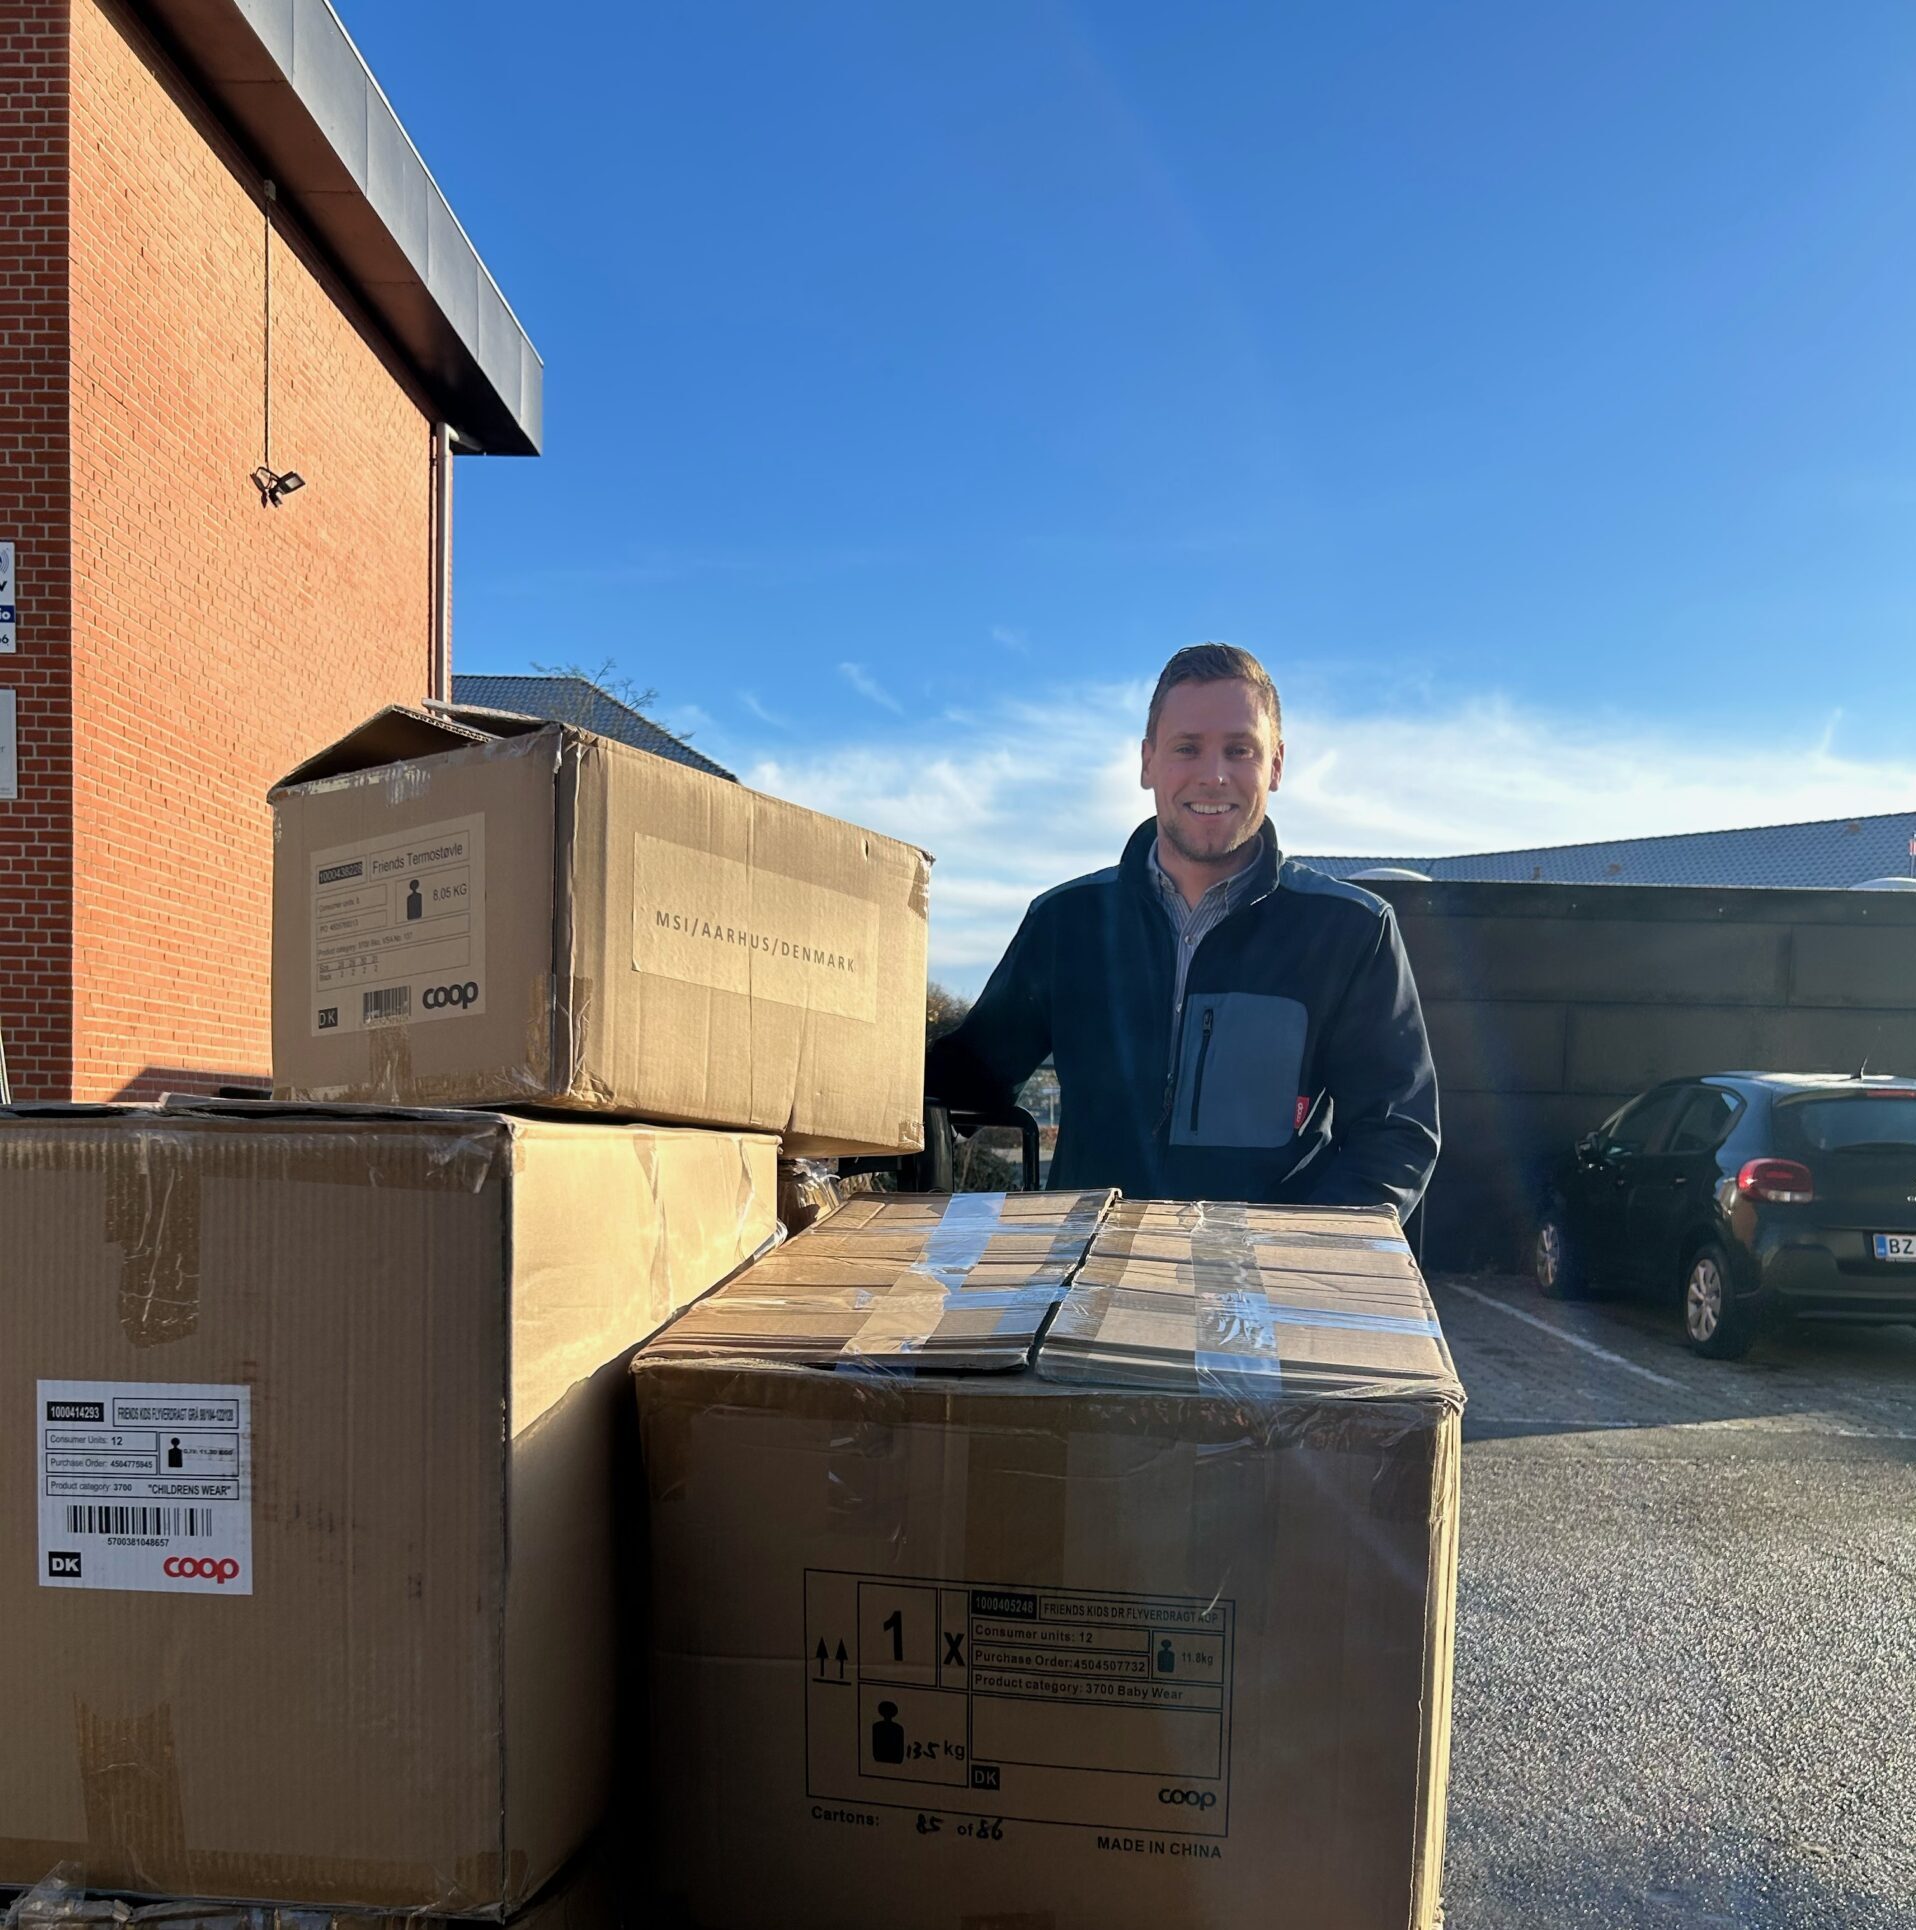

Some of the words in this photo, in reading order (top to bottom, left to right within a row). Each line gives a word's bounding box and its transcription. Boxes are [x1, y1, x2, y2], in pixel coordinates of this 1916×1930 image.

[372, 856, 405, 875] Friends
[407, 843, 463, 867] Termostøvle
[453, 883, 468, 897] KG
[656, 910, 855, 974] MSI/AARHUS/DENMARK
[422, 981, 479, 1010] coop
[319, 1010, 337, 1026] DK
[1889, 1238, 1914, 1255] BZ
[50, 1406, 100, 1420] 1000414293
[50, 1434, 87, 1445] Consumer
[111, 1437, 123, 1446] 12
[50, 1458, 84, 1468] Purchase
[50, 1481, 78, 1491] Product
[113, 1483, 132, 1492] 3700
[107, 1538, 170, 1548] 5700381048657
[52, 1557, 79, 1572] DK
[163, 1556, 240, 1584] coop
[975, 1596, 1035, 1615] 1000405248
[1043, 1602, 1085, 1617] FRIENDS
[1086, 1605, 1110, 1619] KIDS
[1110, 1607, 1125, 1620] DR
[1125, 1607, 1197, 1624] FLYVERDRAGT
[882, 1609, 905, 1662] 1
[975, 1624, 1036, 1641] Consumer
[1038, 1628, 1076, 1643] units:
[1078, 1632, 1094, 1644] 12
[975, 1649, 1032, 1666] Purchase
[975, 1674, 1023, 1690] Product
[1024, 1677, 1084, 1696] category:
[1085, 1682, 1115, 1696] 3700
[1117, 1684, 1149, 1700] Baby
[1151, 1687, 1184, 1701] Wear
[943, 1739, 966, 1761] kg
[974, 1769, 997, 1786] DK
[1158, 1787, 1217, 1812] coop
[811, 1805, 880, 1827] Cartons:
[957, 1823, 974, 1837] of
[1097, 1835, 1145, 1853] MADE
[1149, 1839, 1165, 1855] IN
[1169, 1841, 1222, 1860] CHINA
